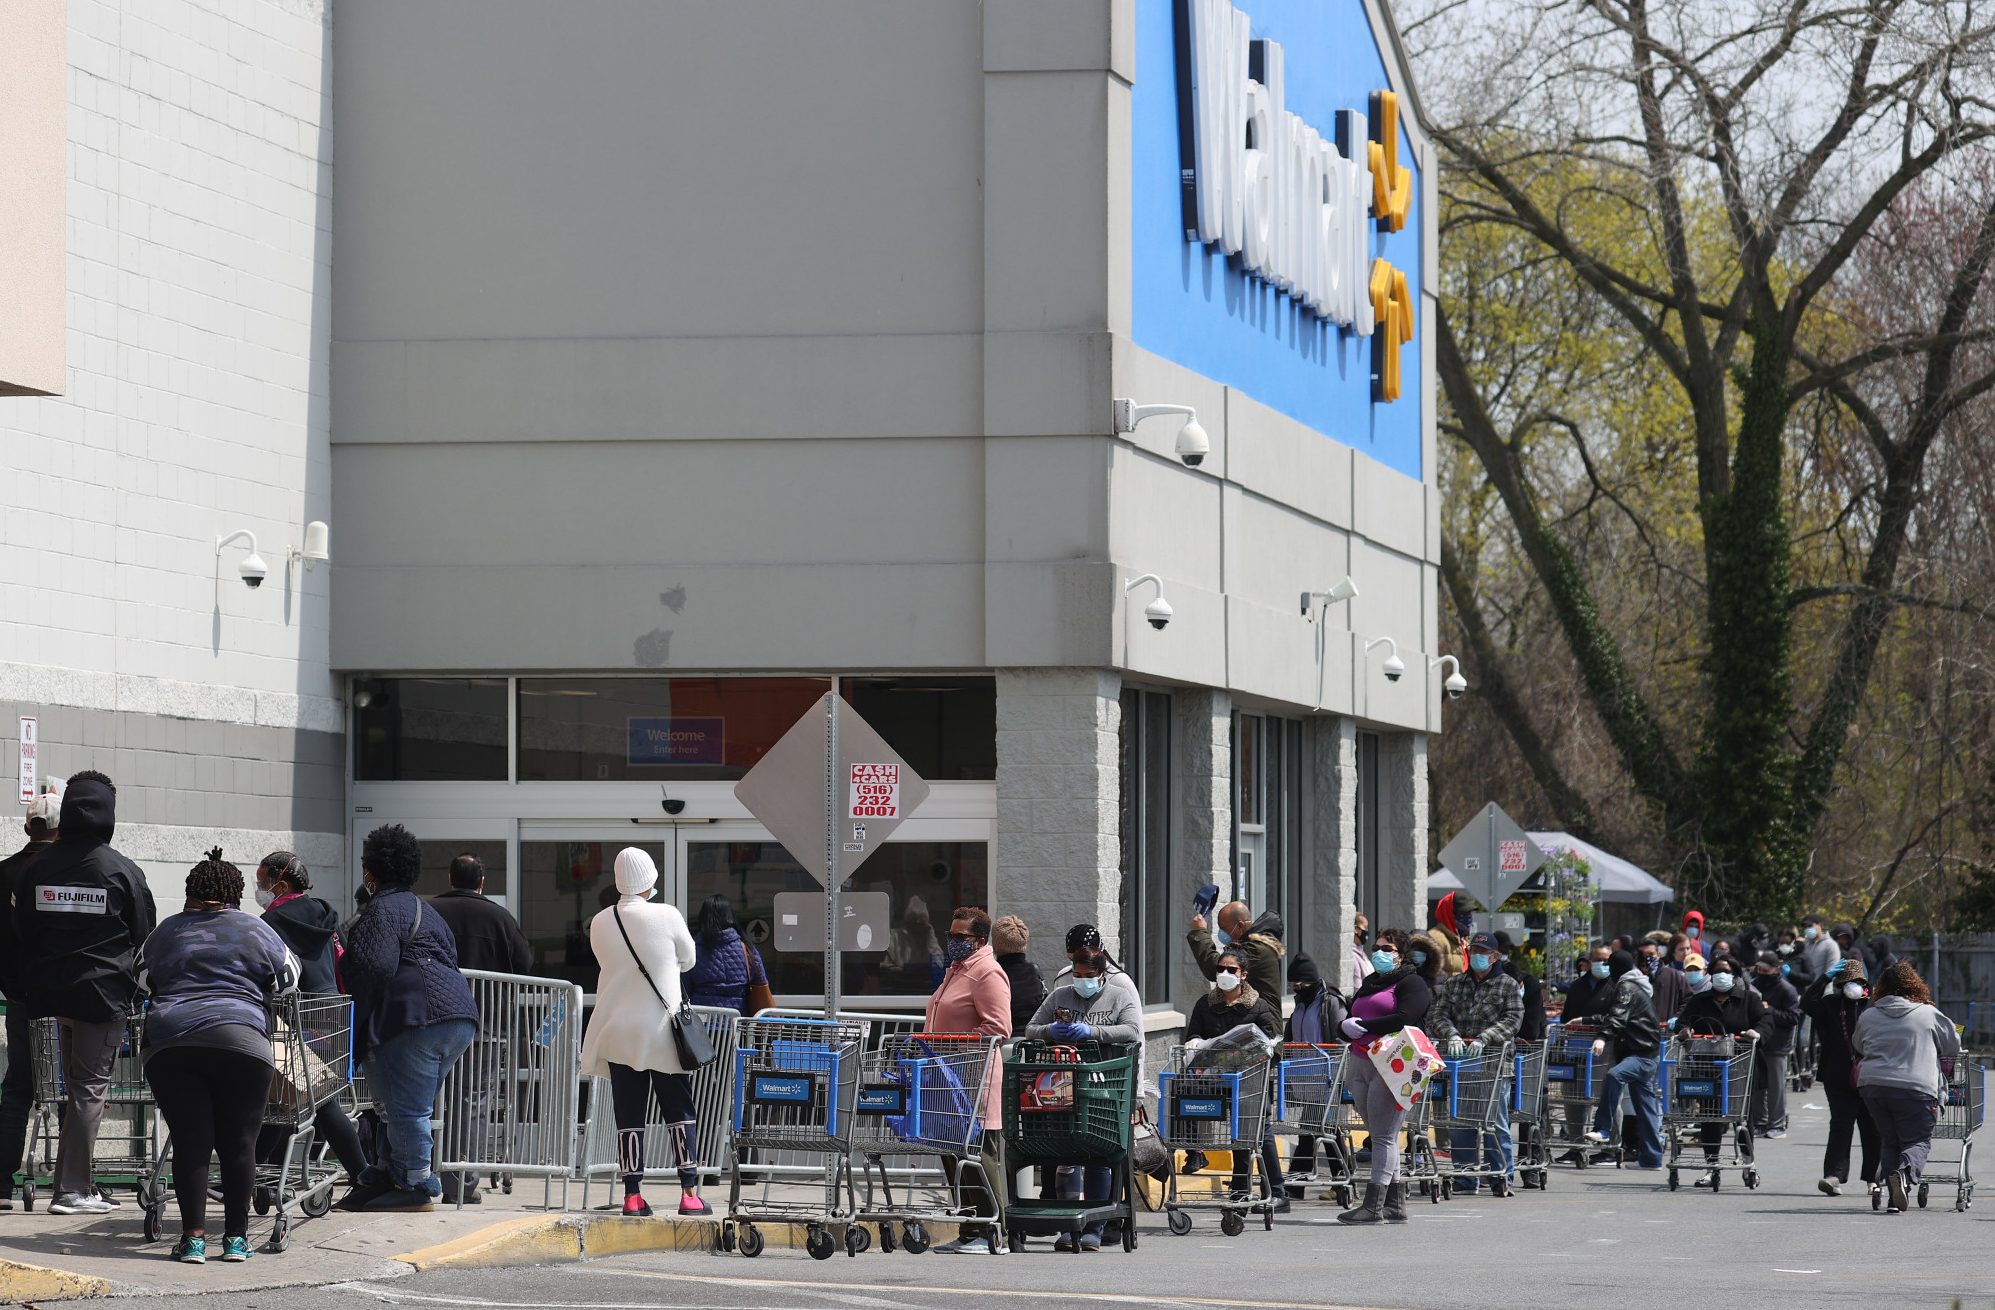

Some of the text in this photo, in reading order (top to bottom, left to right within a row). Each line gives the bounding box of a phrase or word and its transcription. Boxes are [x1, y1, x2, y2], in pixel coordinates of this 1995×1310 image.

[647, 728, 705, 741] Welcome
[679, 745, 699, 754] here
[852, 775, 897, 784] 4CARS
[856, 784, 894, 795] (516)
[857, 795, 891, 806] 232
[852, 806, 896, 817] 0007
[57, 892, 105, 904] FUJIFILM
[1058, 1007, 1115, 1026] INK
[762, 1084, 791, 1092] Walmart
